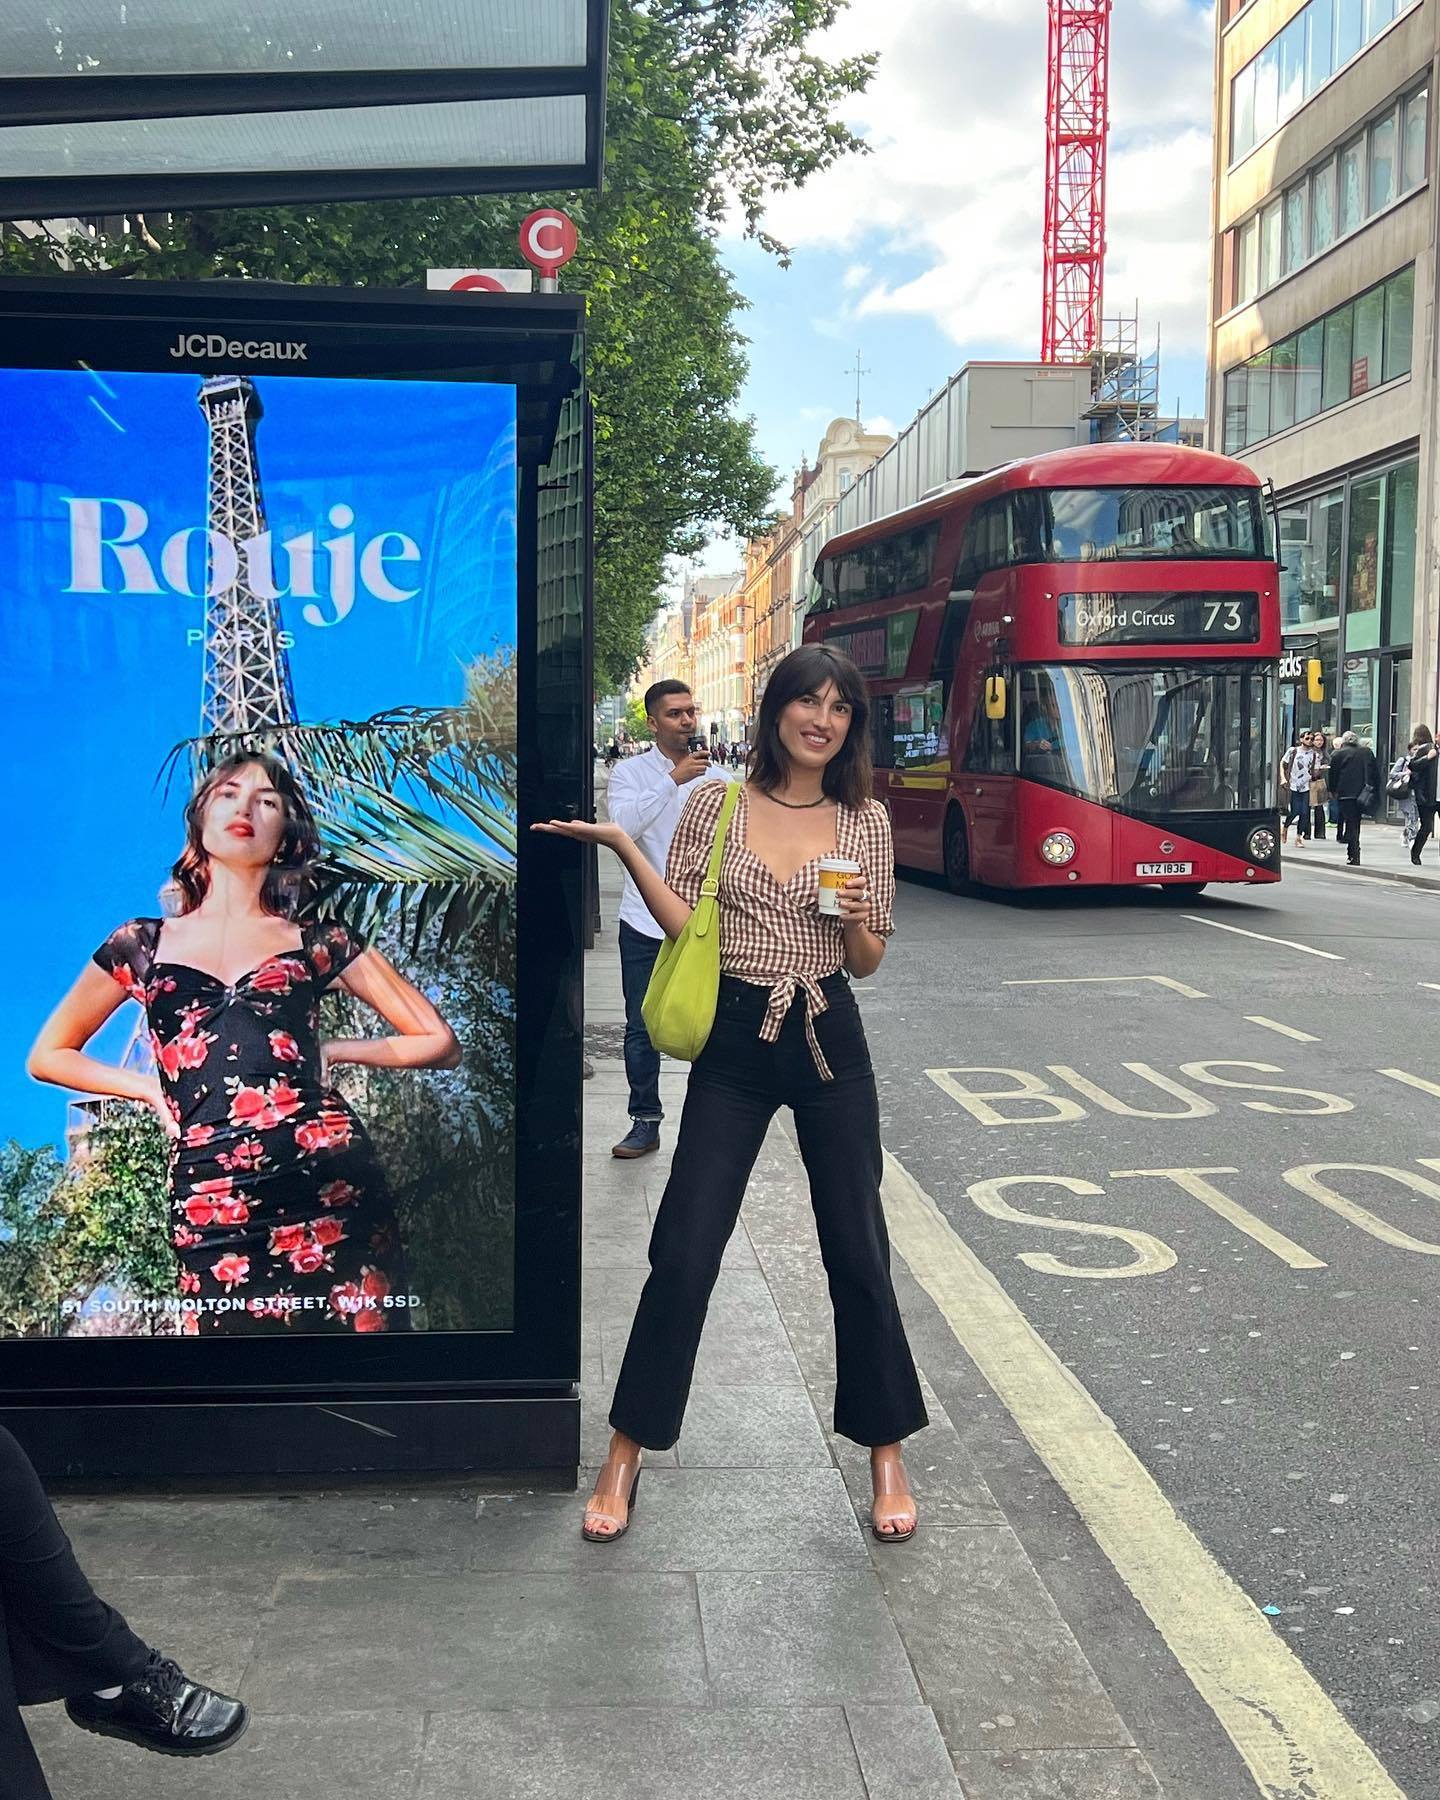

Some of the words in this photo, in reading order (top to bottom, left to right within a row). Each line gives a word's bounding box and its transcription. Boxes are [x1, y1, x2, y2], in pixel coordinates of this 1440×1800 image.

[528, 217, 564, 260] C
[169, 334, 308, 360] JCDecaux
[59, 496, 422, 627] Rouje
[1076, 610, 1127, 628] Oxford
[1132, 610, 1176, 627] Circus
[1203, 601, 1242, 632] 73
[186, 628, 296, 649] PARIS
[1278, 650, 1303, 679] acks
[1142, 863, 1162, 875] LTZ
[1163, 863, 1186, 874] 1836
[924, 1060, 1356, 1126] BUS
[966, 1158, 1440, 1279] STO
[62, 1302, 82, 1314] 51
[90, 1300, 159, 1314] SOUTH
[164, 1298, 246, 1312] MOLTON
[252, 1296, 331, 1311] STREET,
[337, 1295, 377, 1309] W1K
